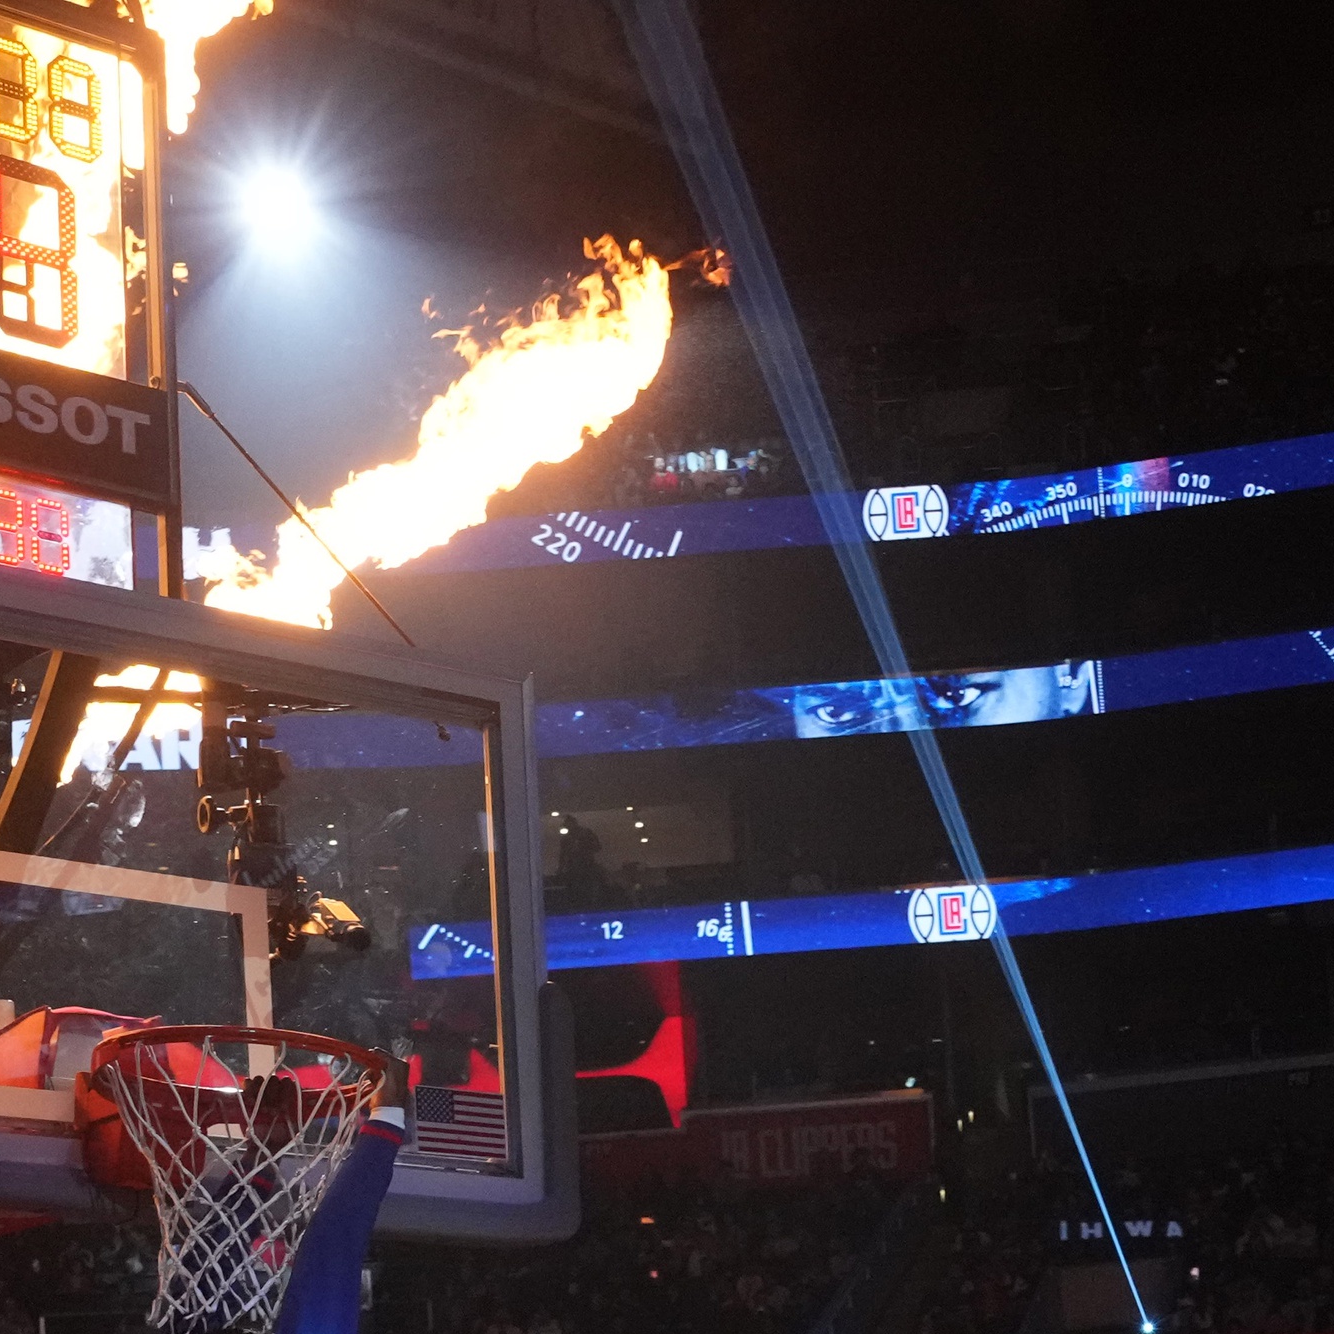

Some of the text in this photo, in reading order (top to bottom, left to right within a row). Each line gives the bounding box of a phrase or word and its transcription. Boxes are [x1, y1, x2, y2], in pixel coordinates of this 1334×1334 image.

[980, 500, 1014, 524] 340
[1044, 481, 1078, 502] 350
[1177, 472, 1211, 490] 010
[530, 522, 583, 564] 220
[600, 920, 625, 940] 12
